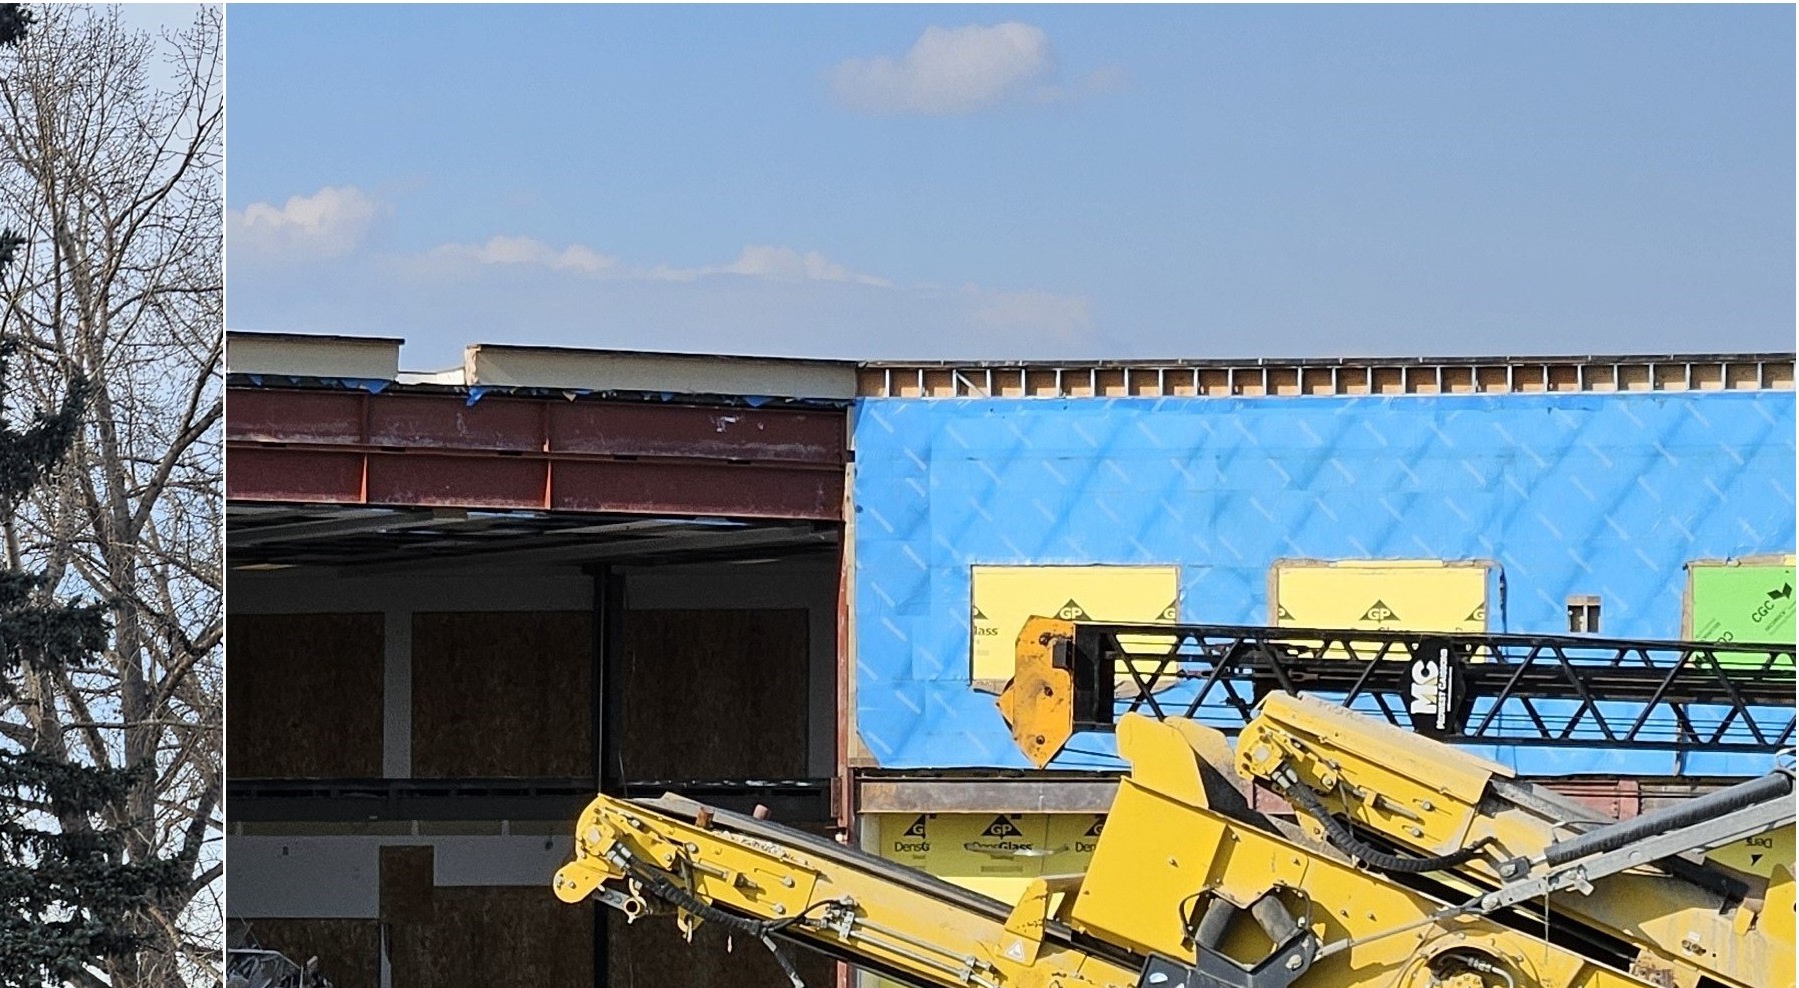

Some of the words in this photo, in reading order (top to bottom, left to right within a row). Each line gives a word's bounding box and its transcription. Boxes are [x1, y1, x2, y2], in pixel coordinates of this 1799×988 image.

[1059, 606, 1083, 620] GP
[1367, 607, 1391, 620] GP
[1751, 600, 1775, 623] CGC
[1411, 660, 1439, 714] MC
[990, 823, 1013, 835] GP
